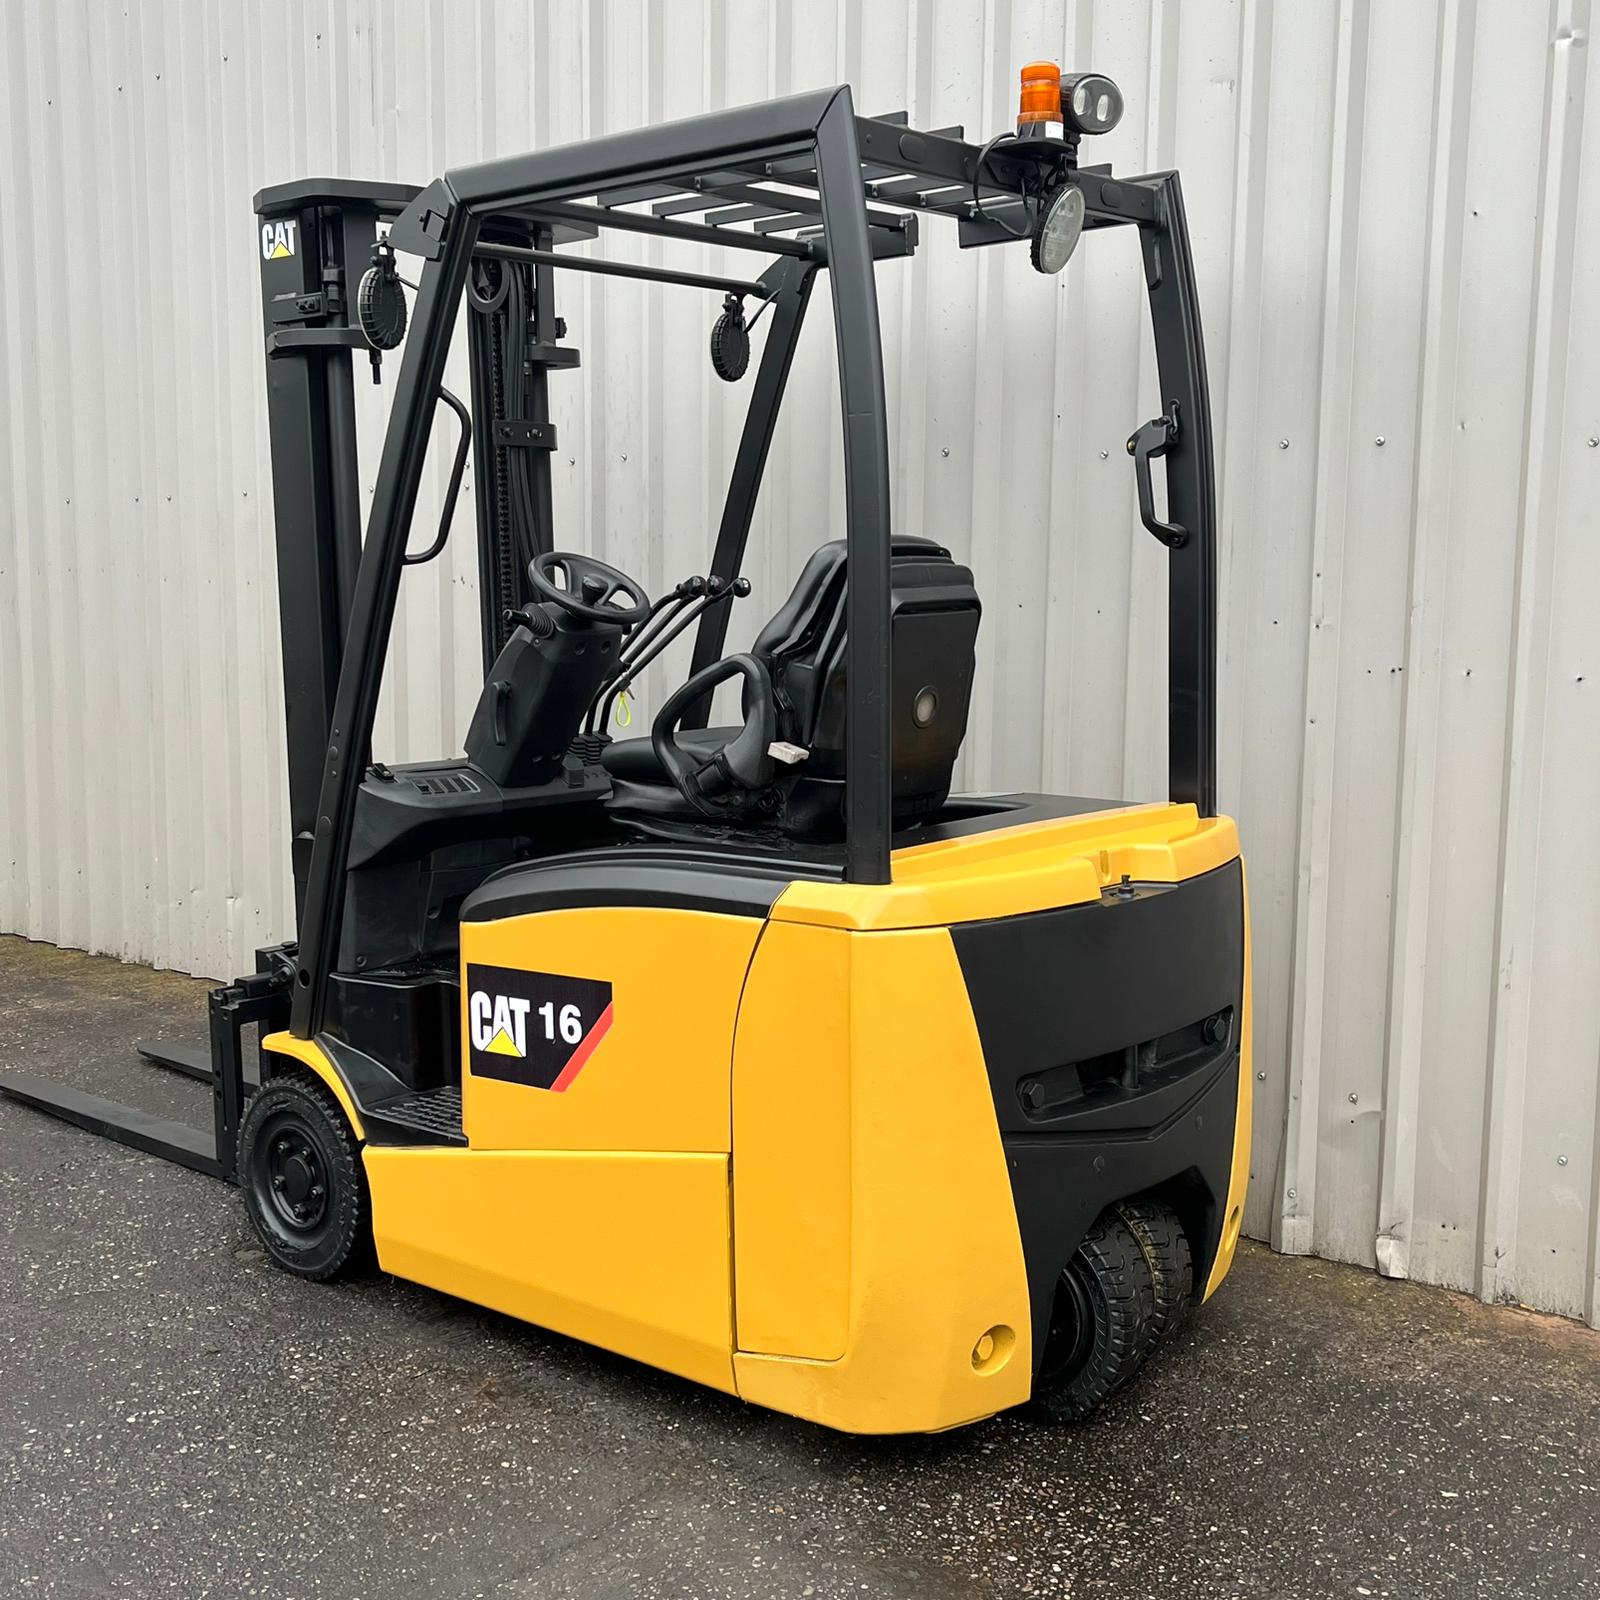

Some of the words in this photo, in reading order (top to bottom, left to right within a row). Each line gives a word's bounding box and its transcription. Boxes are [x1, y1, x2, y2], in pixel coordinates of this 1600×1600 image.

[262, 220, 296, 260] CAT
[470, 991, 530, 1058] CAT
[538, 1001, 583, 1045] 16
